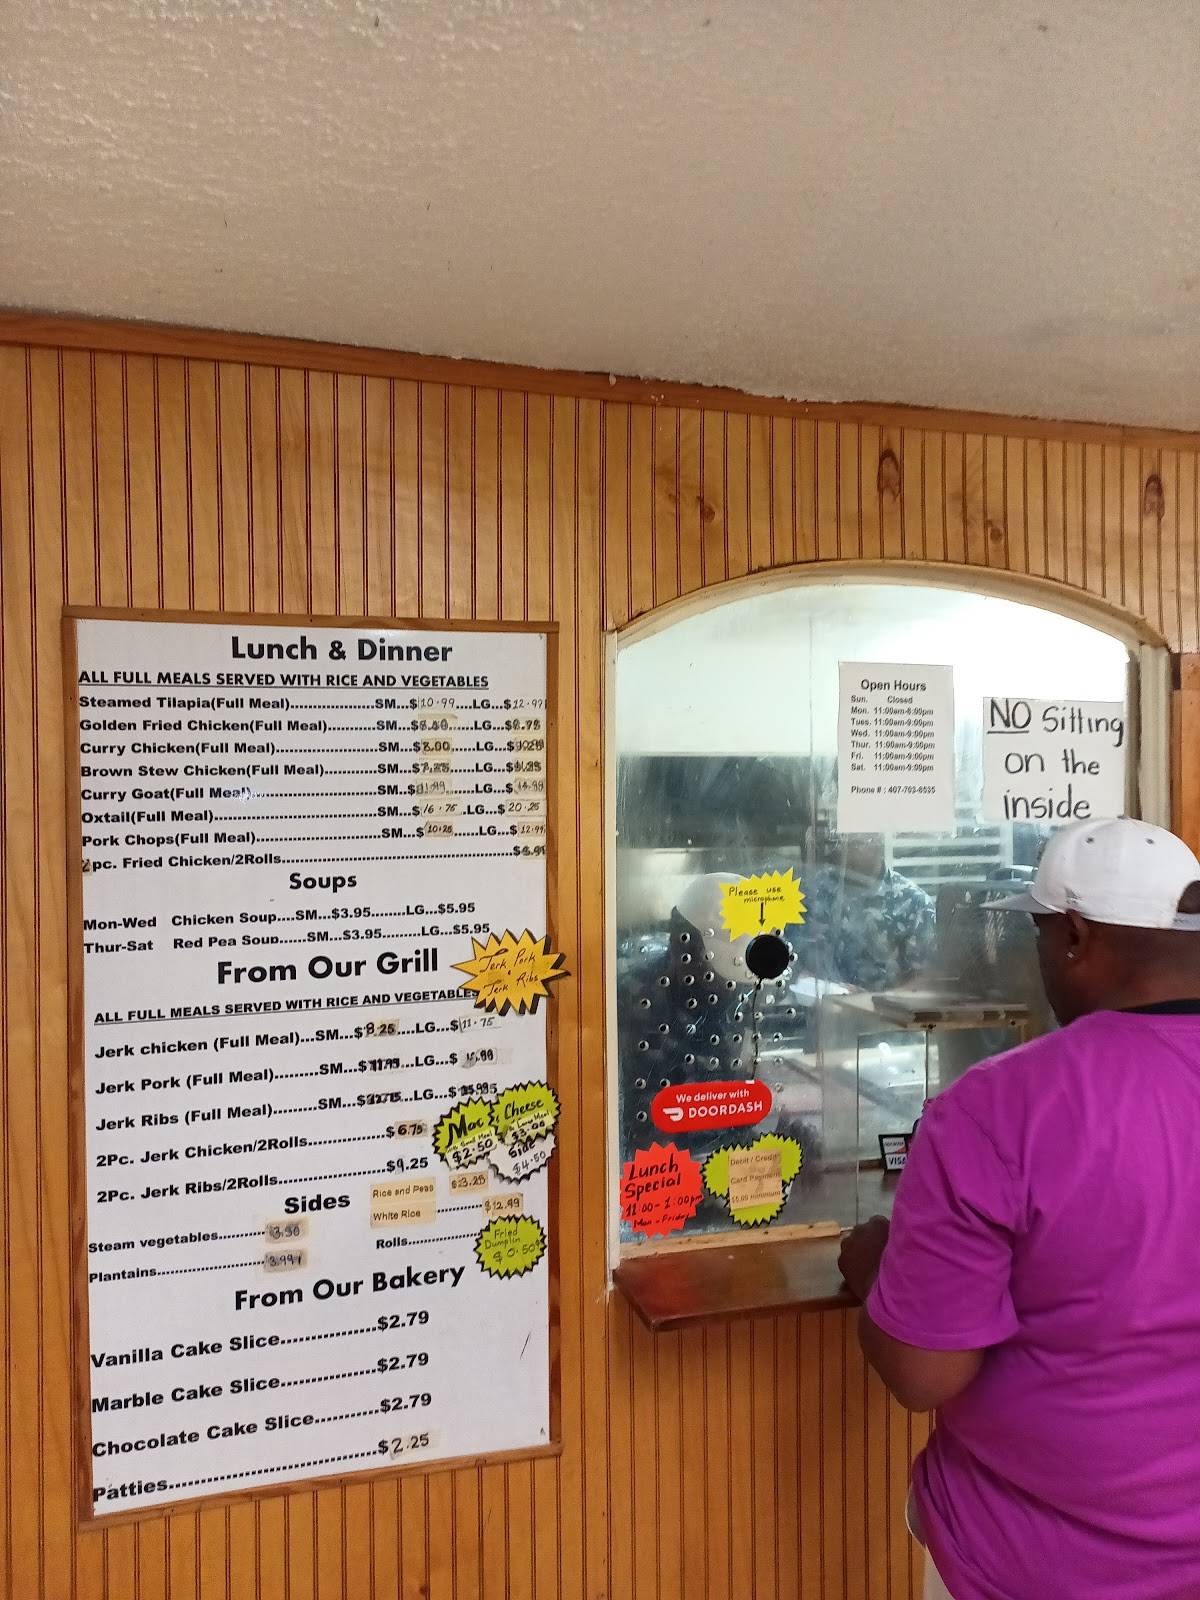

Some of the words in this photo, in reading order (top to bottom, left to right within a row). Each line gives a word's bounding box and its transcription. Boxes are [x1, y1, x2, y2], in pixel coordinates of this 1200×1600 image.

[231, 635, 317, 660] Lunch
[328, 640, 347, 661] &
[357, 638, 453, 662] Dinner
[78, 671, 108, 684] ALL
[113, 671, 151, 684] FULL
[157, 672, 211, 685] MEALS
[216, 673, 275, 686] SERVED
[280, 674, 321, 686] WITH
[326, 674, 358, 687] RICE
[362, 675, 397, 687] AND
[401, 675, 489, 688] VEGETABLES
[860, 679, 890, 692] Open
[894, 679, 927, 692] Hours
[79, 696, 151, 708] Steamed
[851, 695, 868, 703] Sun.
[887, 695, 913, 704] Closed
[851, 706, 869, 715] Mon.
[79, 719, 137, 732] Golden
[142, 719, 182, 731] Fried
[990, 697, 1032, 730] NO
[1042, 705, 1124, 748] Sitting
[80, 743, 126, 757] Curry
[1004, 752, 1045, 774] on
[1061, 748, 1100, 775] the
[81, 766, 133, 777] Brown
[138, 765, 178, 777] Stew
[81, 789, 127, 802] Curry
[851, 785, 875, 794] Phone
[1003, 783, 1092, 820] inside
[82, 835, 119, 847] Pork
[123, 857, 163, 869] Fried
[289, 872, 357, 892] Soups
[729, 886, 758, 896] Please
[84, 917, 157, 930] Mon-Wed
[172, 913, 234, 926] Chicken
[240, 912, 277, 924] Soup
[84, 940, 154, 954] Thur-Sat
[173, 937, 203, 949] Red
[208, 936, 237, 947] Pea
[242, 935, 279, 947] Soup
[217, 961, 297, 984] From
[308, 954, 367, 979] Our
[376, 947, 438, 975] Grill
[514, 948, 536, 967] Pork
[517, 970, 538, 987] Ribs
[94, 1011, 123, 1024] ALL
[127, 1008, 166, 1021] FULL
[170, 1005, 221, 1018] MEALS
[225, 1001, 281, 1014] SERVED
[286, 998, 322, 1010] WITH
[326, 994, 358, 1007] RICE
[362, 991, 396, 1004] AND
[95, 1045, 135, 1059] Jerk
[140, 1040, 208, 1055] chicken
[213, 1036, 250, 1052] (Full
[96, 1080, 135, 1095] Jerk
[141, 1076, 181, 1090] Pork
[186, 1072, 223, 1089] (Full
[676, 1093, 692, 1103] We
[694, 1090, 728, 1102] deliver
[729, 1088, 750, 1098] with
[688, 1100, 763, 1119] DOORDASH
[96, 1116, 135, 1131] Jerk
[142, 1112, 179, 1127] Ribs
[184, 1108, 221, 1125] (Full
[445, 1114, 484, 1149] Mac
[504, 1099, 545, 1120] Cheese
[96, 1154, 134, 1167] 2Pc.
[140, 1149, 179, 1163] Jerk
[628, 1152, 679, 1181] Lunch
[97, 1190, 135, 1203] 2Pc.
[141, 1185, 180, 1199] Jerk
[373, 1189, 392, 1199] Rice
[395, 1185, 411, 1196] and
[413, 1184, 435, 1194] Peas
[624, 1172, 681, 1201] Special
[284, 1192, 351, 1215] Sides
[373, 1210, 399, 1222] White
[402, 1209, 421, 1219] Rice
[88, 1242, 135, 1253] Steam
[140, 1231, 219, 1248] vegetables
[494, 1228, 518, 1239] Fried
[376, 1237, 407, 1250] Rolls
[89, 1267, 157, 1283] Plantains
[235, 1288, 303, 1311] From
[312, 1279, 364, 1301] Our
[372, 1265, 466, 1293] Bakery
[91, 1348, 164, 1368] Vanilla
[171, 1341, 222, 1358] Cake
[229, 1334, 280, 1351] Slice
[377, 1310, 430, 1332] $2.79
[92, 1392, 164, 1413] Marble
[171, 1385, 223, 1401] Cake
[230, 1377, 280, 1394] Slice
[377, 1352, 429, 1374] $2.79
[92, 1430, 200, 1457] Chocolate
[207, 1422, 258, 1440] Cake
[265, 1414, 315, 1431] Slice
[380, 1393, 432, 1414] $2.79
[93, 1478, 168, 1502] Patties
